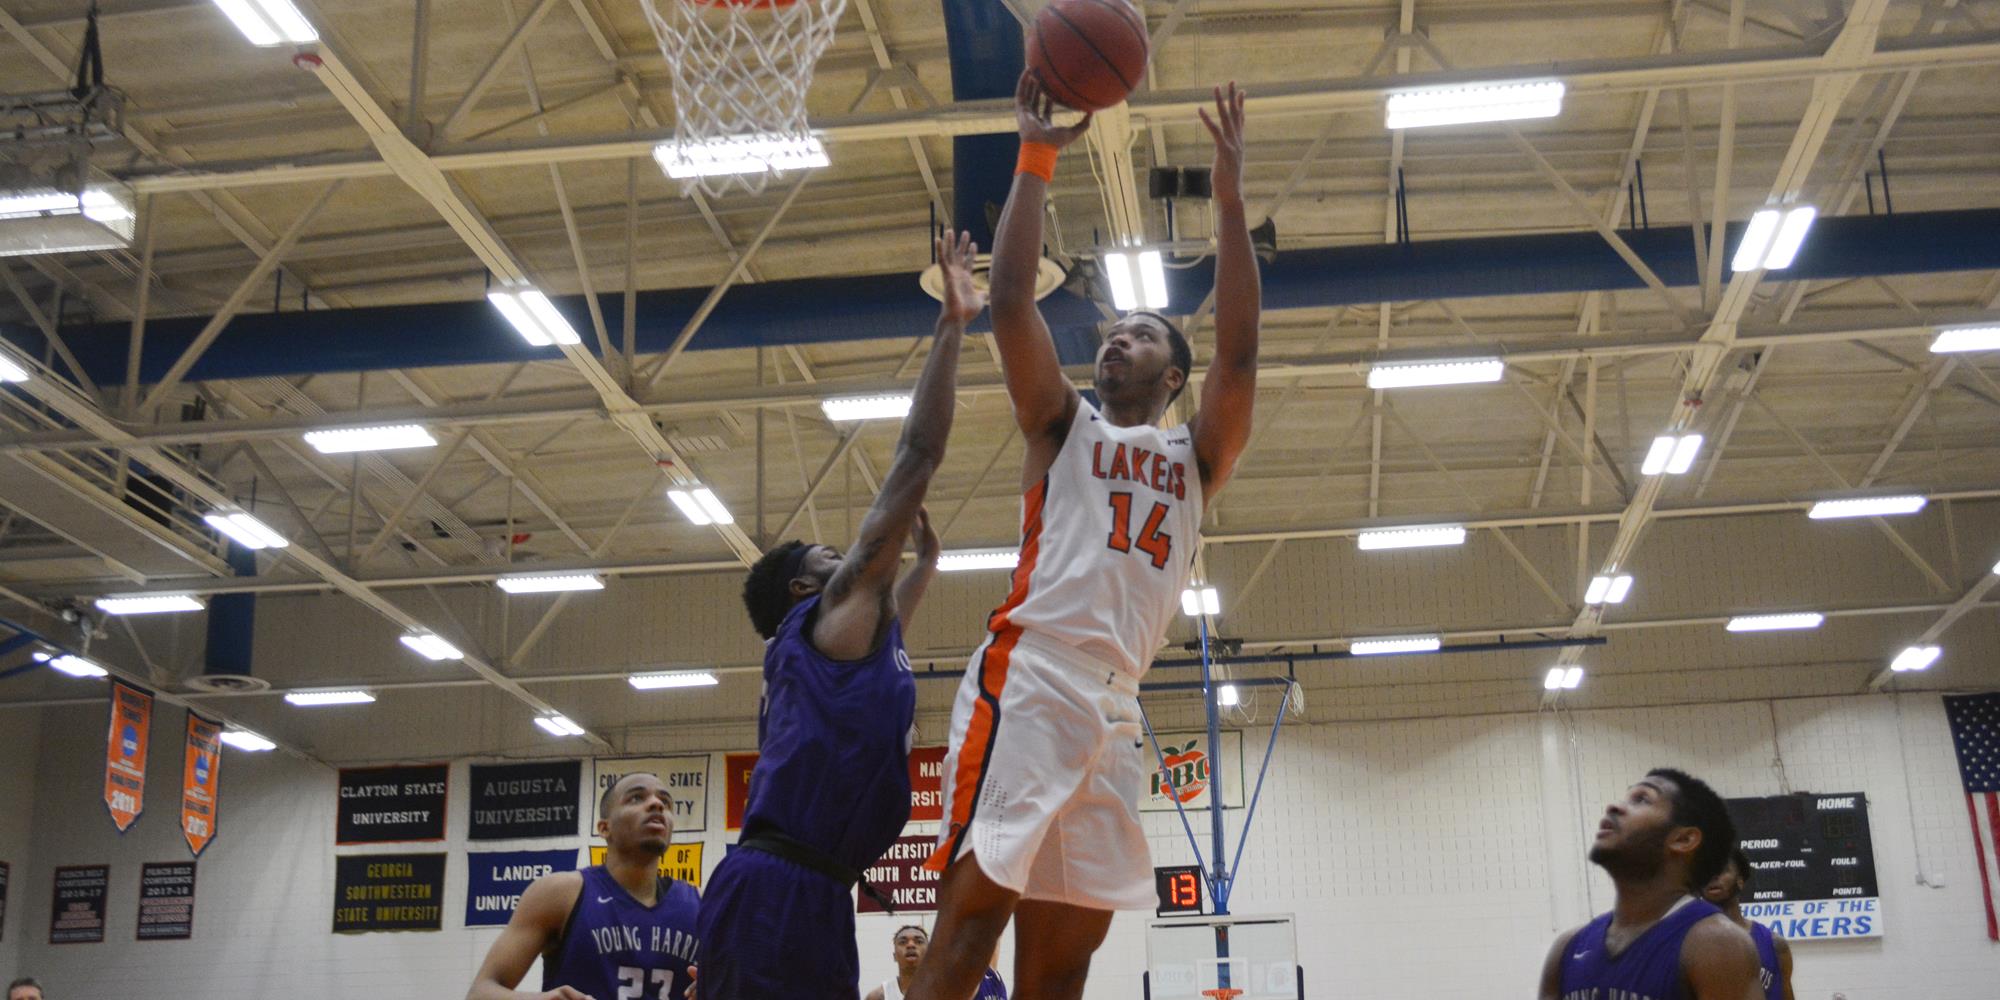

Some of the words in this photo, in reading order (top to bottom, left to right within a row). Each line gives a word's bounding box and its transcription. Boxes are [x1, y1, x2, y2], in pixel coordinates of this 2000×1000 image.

[1107, 491, 1172, 571] 14
[920, 762, 943, 778] MAR
[484, 778, 567, 797] AUGUSTA
[670, 772, 703, 788] STATE
[341, 785, 398, 798] CLAYTON
[404, 782, 445, 796] STATE
[1817, 797, 1855, 810] HOME
[352, 811, 430, 825] UNIVERSITY
[474, 805, 575, 825] UNIVERSITY
[880, 842, 936, 860] VERSITY
[1740, 839, 1779, 850] PERIOD
[677, 850, 691, 864] OF
[1831, 857, 1857, 866] FOULS
[367, 863, 413, 878] GEORGIA
[493, 865, 552, 881] LANDER
[657, 868, 695, 882] ROLINA
[863, 866, 900, 882] SOUTH
[910, 866, 941, 882] CARO
[346, 884, 431, 900] SOUTHWESTERN
[891, 888, 936, 904] AIKEN
[1171, 874, 1197, 905] 13
[1754, 891, 1783, 899] MATCH
[1833, 887, 1862, 896] POINTS
[476, 895, 522, 911] UNIVE
[1739, 903, 1794, 917] HOME
[1803, 902, 1828, 914] OF
[1837, 899, 1875, 912] THE
[337, 908, 368, 922] STATE
[376, 906, 439, 921] UNIVERSITY
[1770, 915, 1873, 938] AKERS
[591, 924, 642, 953] YOUNG
[651, 926, 699, 965] HARRI
